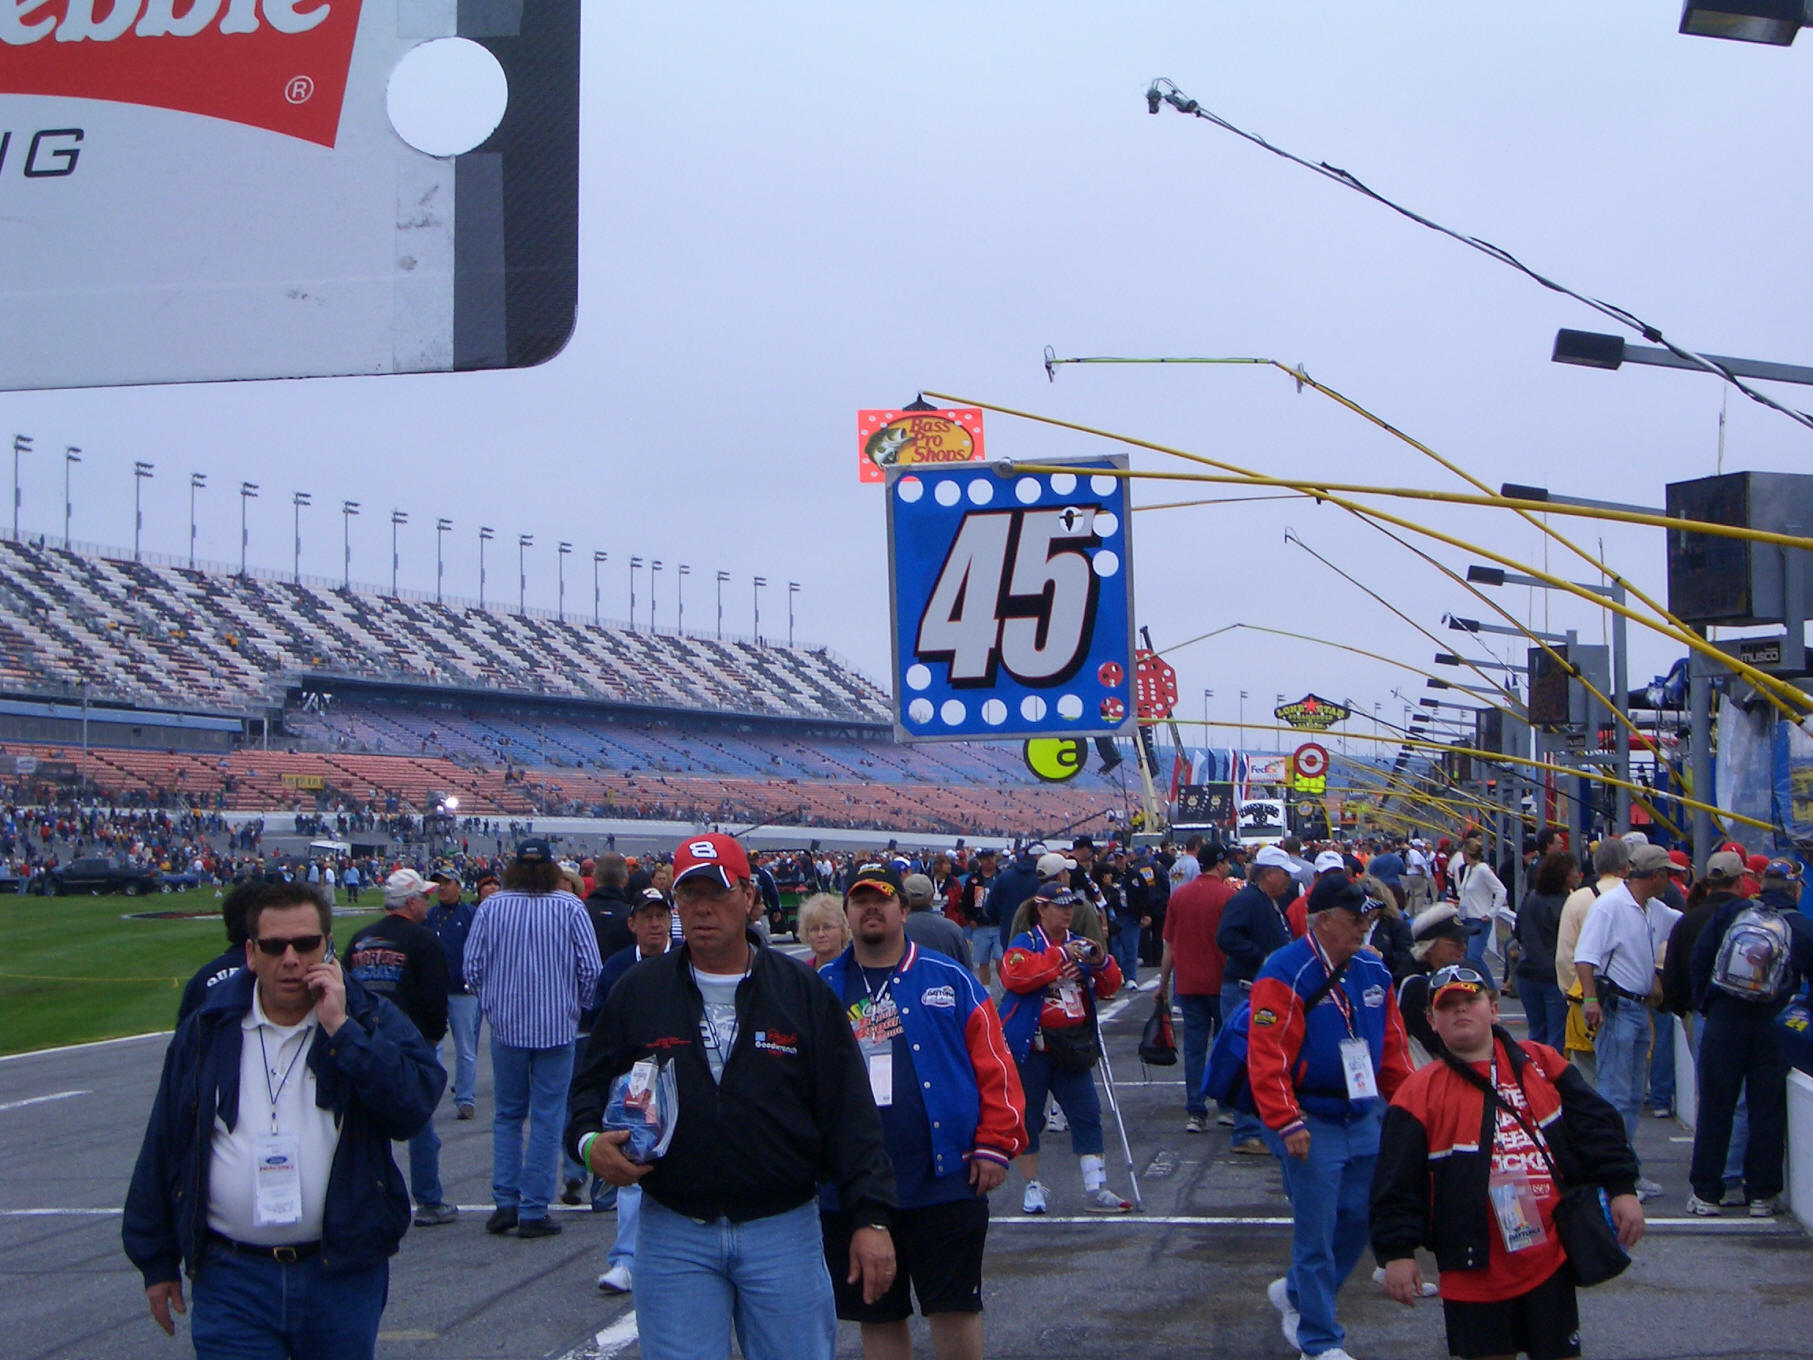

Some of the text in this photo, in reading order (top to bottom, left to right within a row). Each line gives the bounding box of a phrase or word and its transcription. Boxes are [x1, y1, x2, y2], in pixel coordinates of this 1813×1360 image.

[909, 417, 951, 433] Bass
[912, 432, 943, 447] Pro
[911, 446, 966, 463] Shops
[914, 503, 1105, 690] 45
[688, 839, 719, 860] 8
